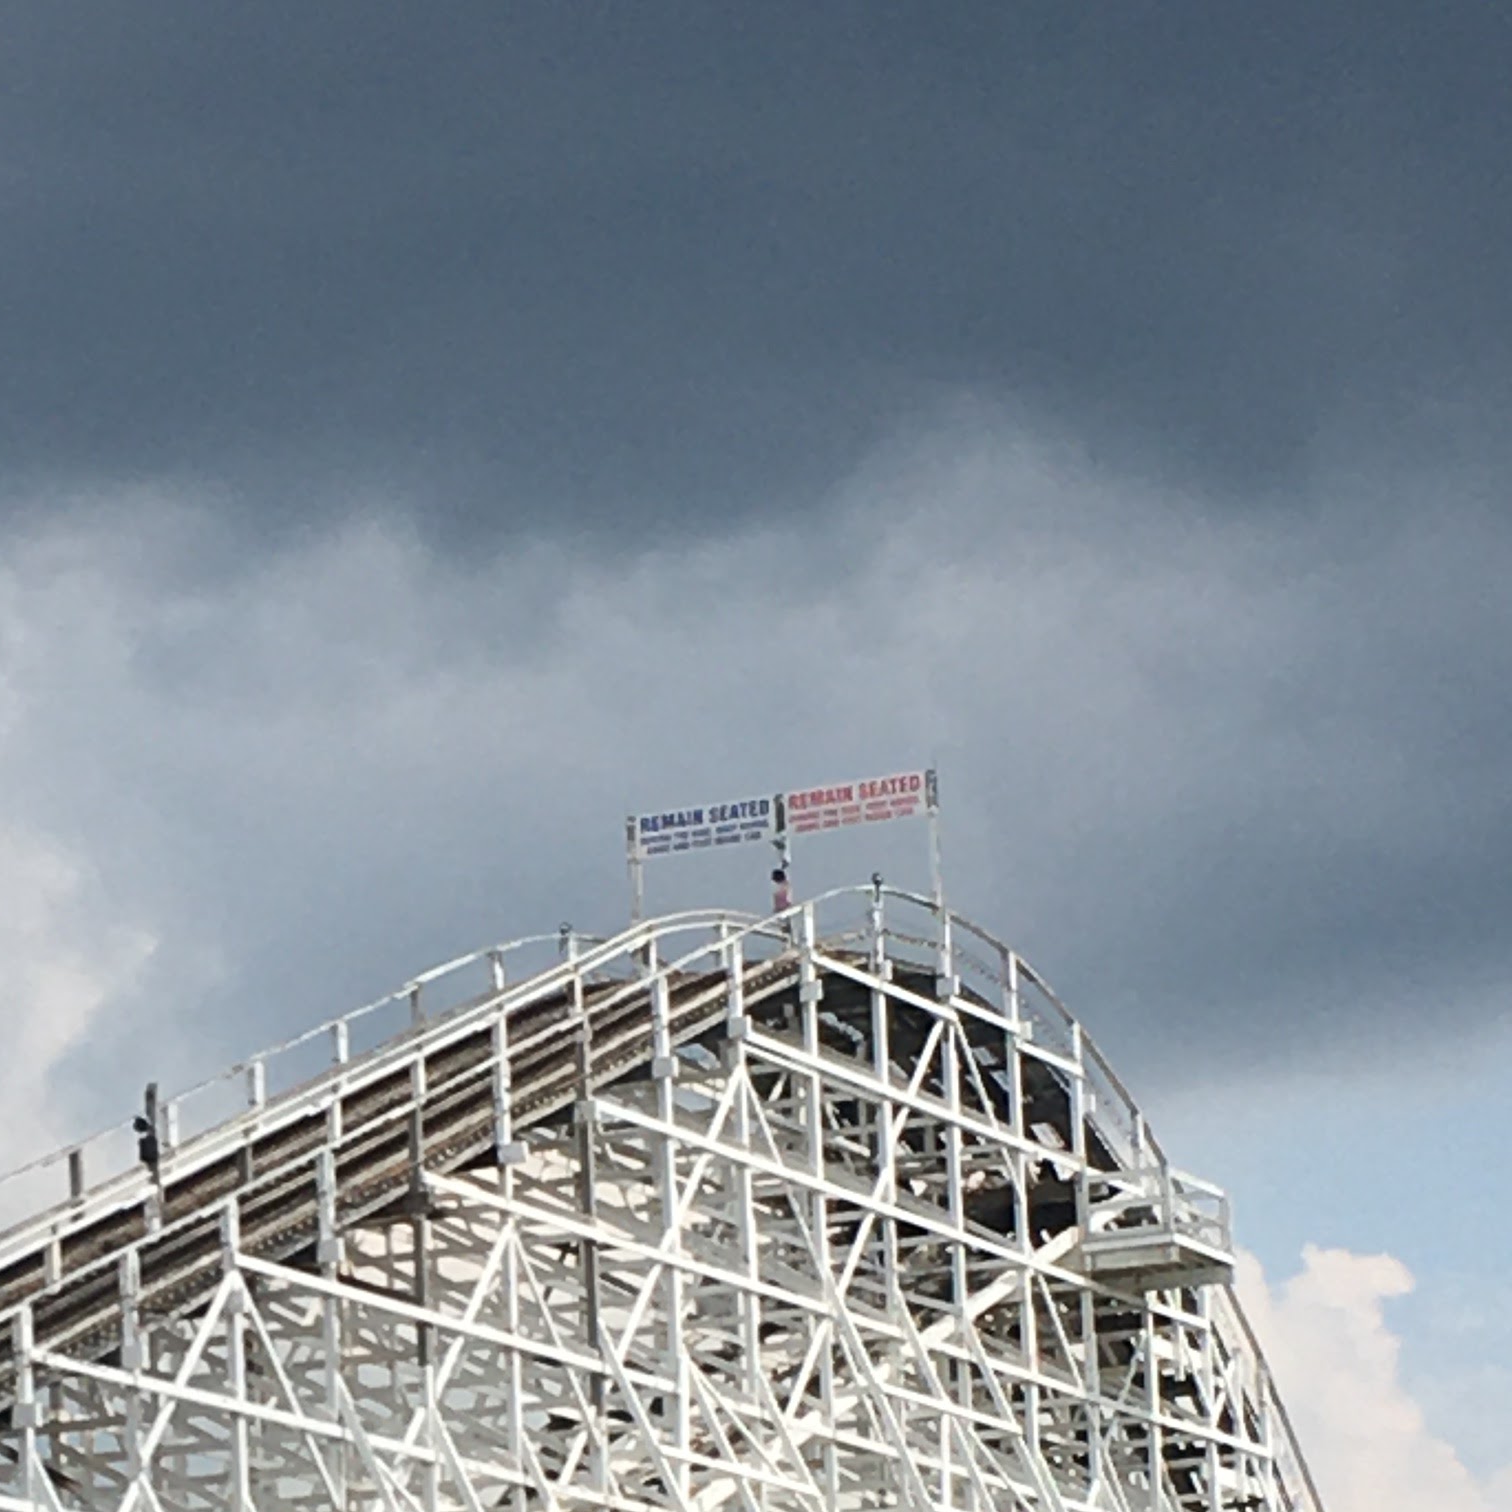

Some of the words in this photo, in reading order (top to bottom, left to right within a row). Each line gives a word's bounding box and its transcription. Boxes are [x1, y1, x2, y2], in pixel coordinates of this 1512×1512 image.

[788, 786, 853, 810] REMAIN
[859, 775, 920, 800] SEATED
[640, 809, 703, 833] REMAIN
[709, 800, 769, 823] SEATED
